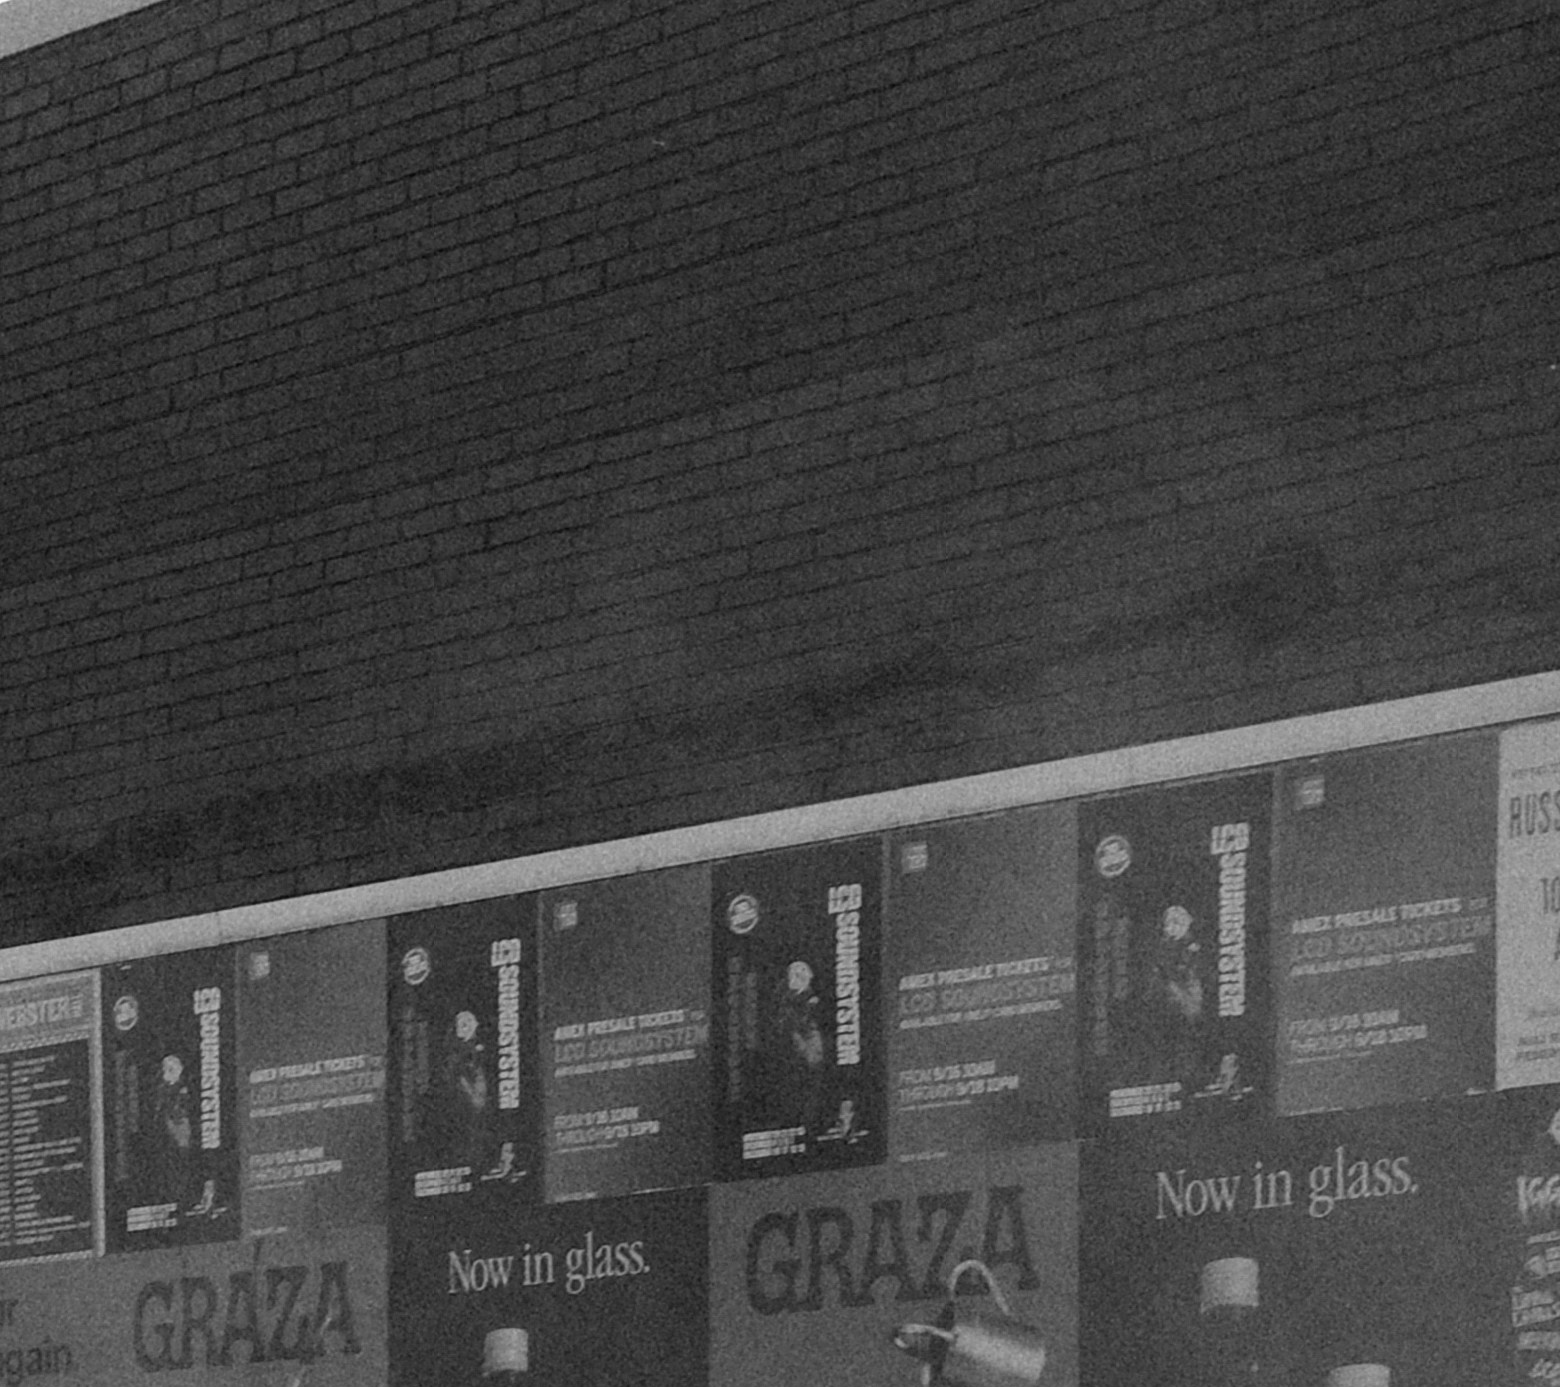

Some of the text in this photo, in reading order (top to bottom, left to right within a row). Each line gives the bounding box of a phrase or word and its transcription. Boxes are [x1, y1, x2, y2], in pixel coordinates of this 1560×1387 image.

[1155, 1146, 1420, 1220] Now in glass.
[447, 1231, 650, 1295] Now in glass.
[746, 1185, 1041, 1316] GRAZA
[133, 1260, 362, 1373] GRAZA
